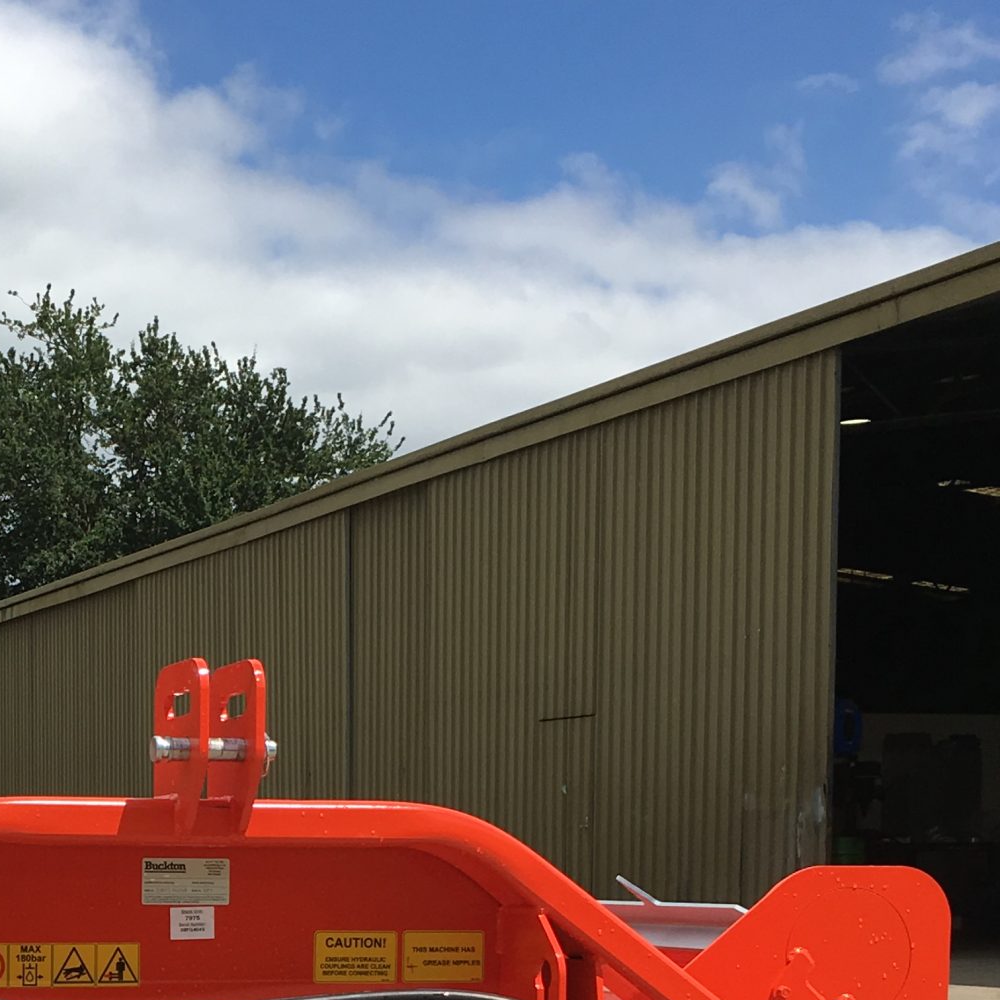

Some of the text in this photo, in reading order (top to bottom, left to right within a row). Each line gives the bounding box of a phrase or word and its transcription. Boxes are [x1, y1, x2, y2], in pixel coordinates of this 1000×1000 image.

[144, 861, 186, 870] Buckton
[325, 937, 387, 948] CAUTION!
[21, 945, 41, 953] MAX
[16, 954, 46, 962] 180bar
